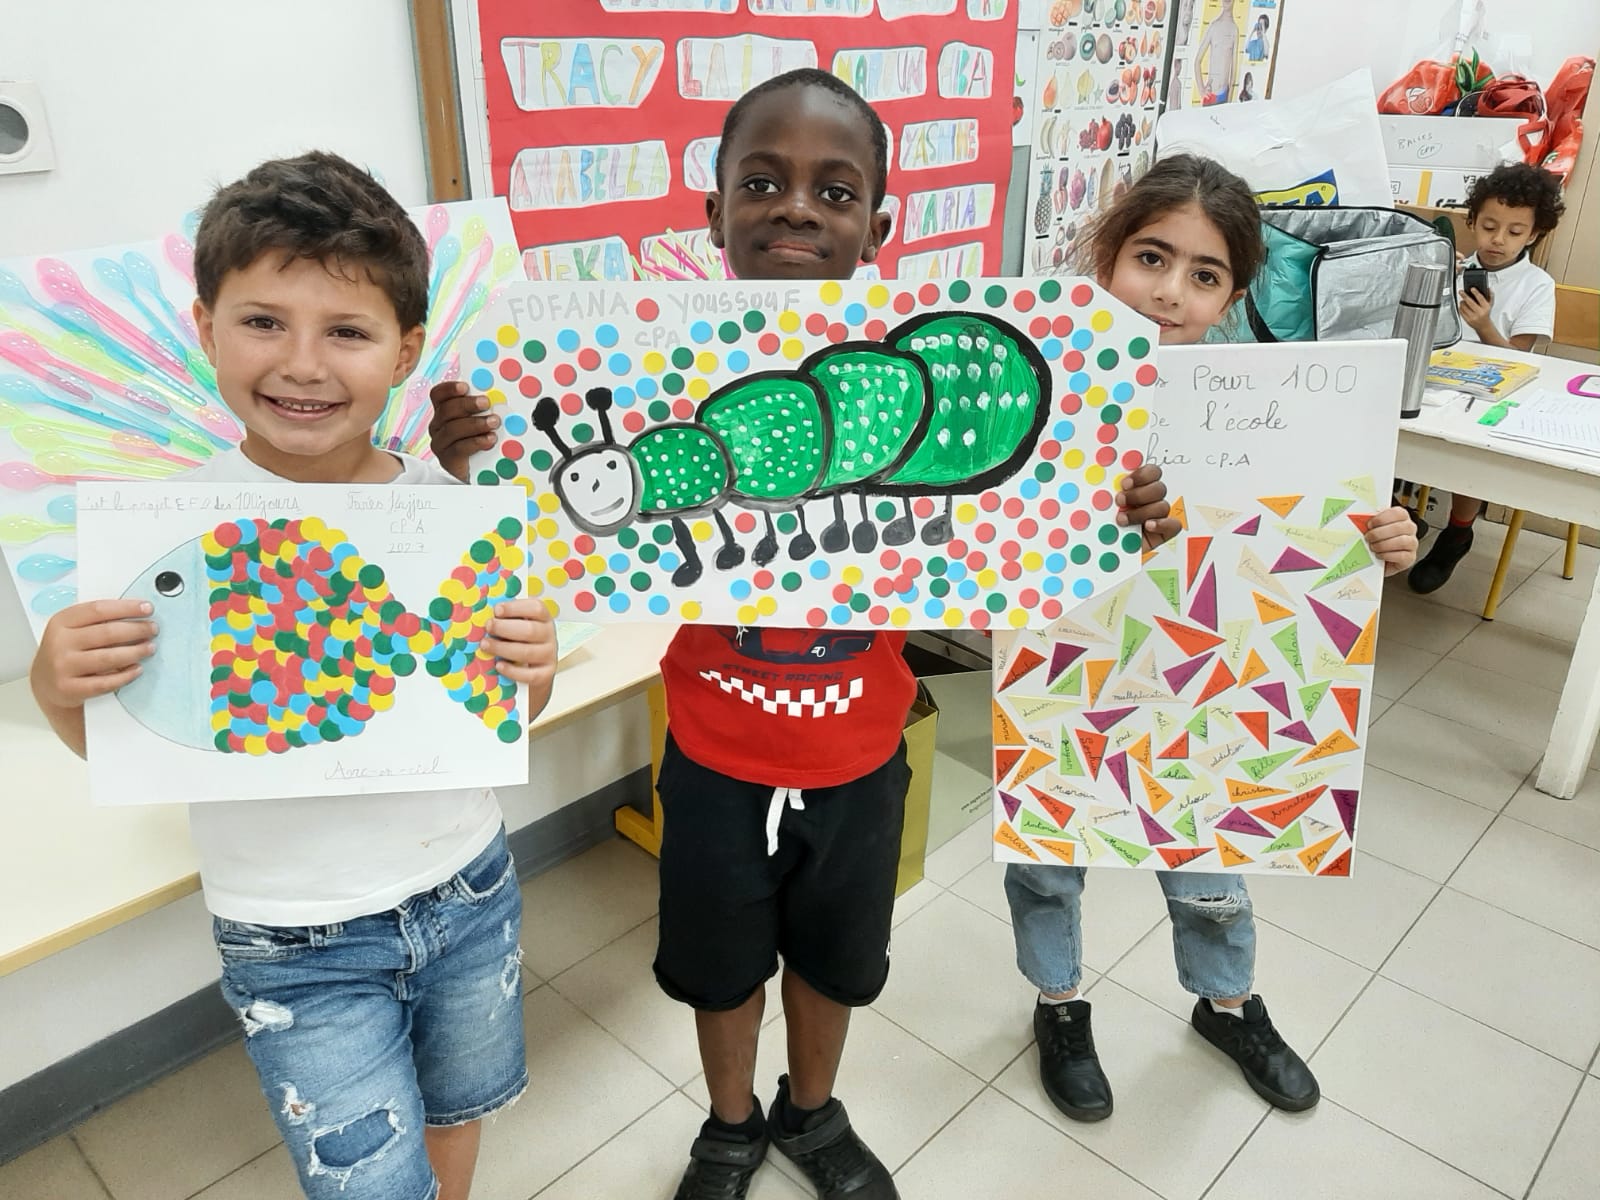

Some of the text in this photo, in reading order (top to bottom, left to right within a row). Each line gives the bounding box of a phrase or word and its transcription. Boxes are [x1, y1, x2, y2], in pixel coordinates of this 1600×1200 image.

[502, 41, 660, 105] TRACY
[507, 289, 630, 327] FOFANA
[634, 326, 681, 349] CPA
[1281, 363, 1358, 393] 100
